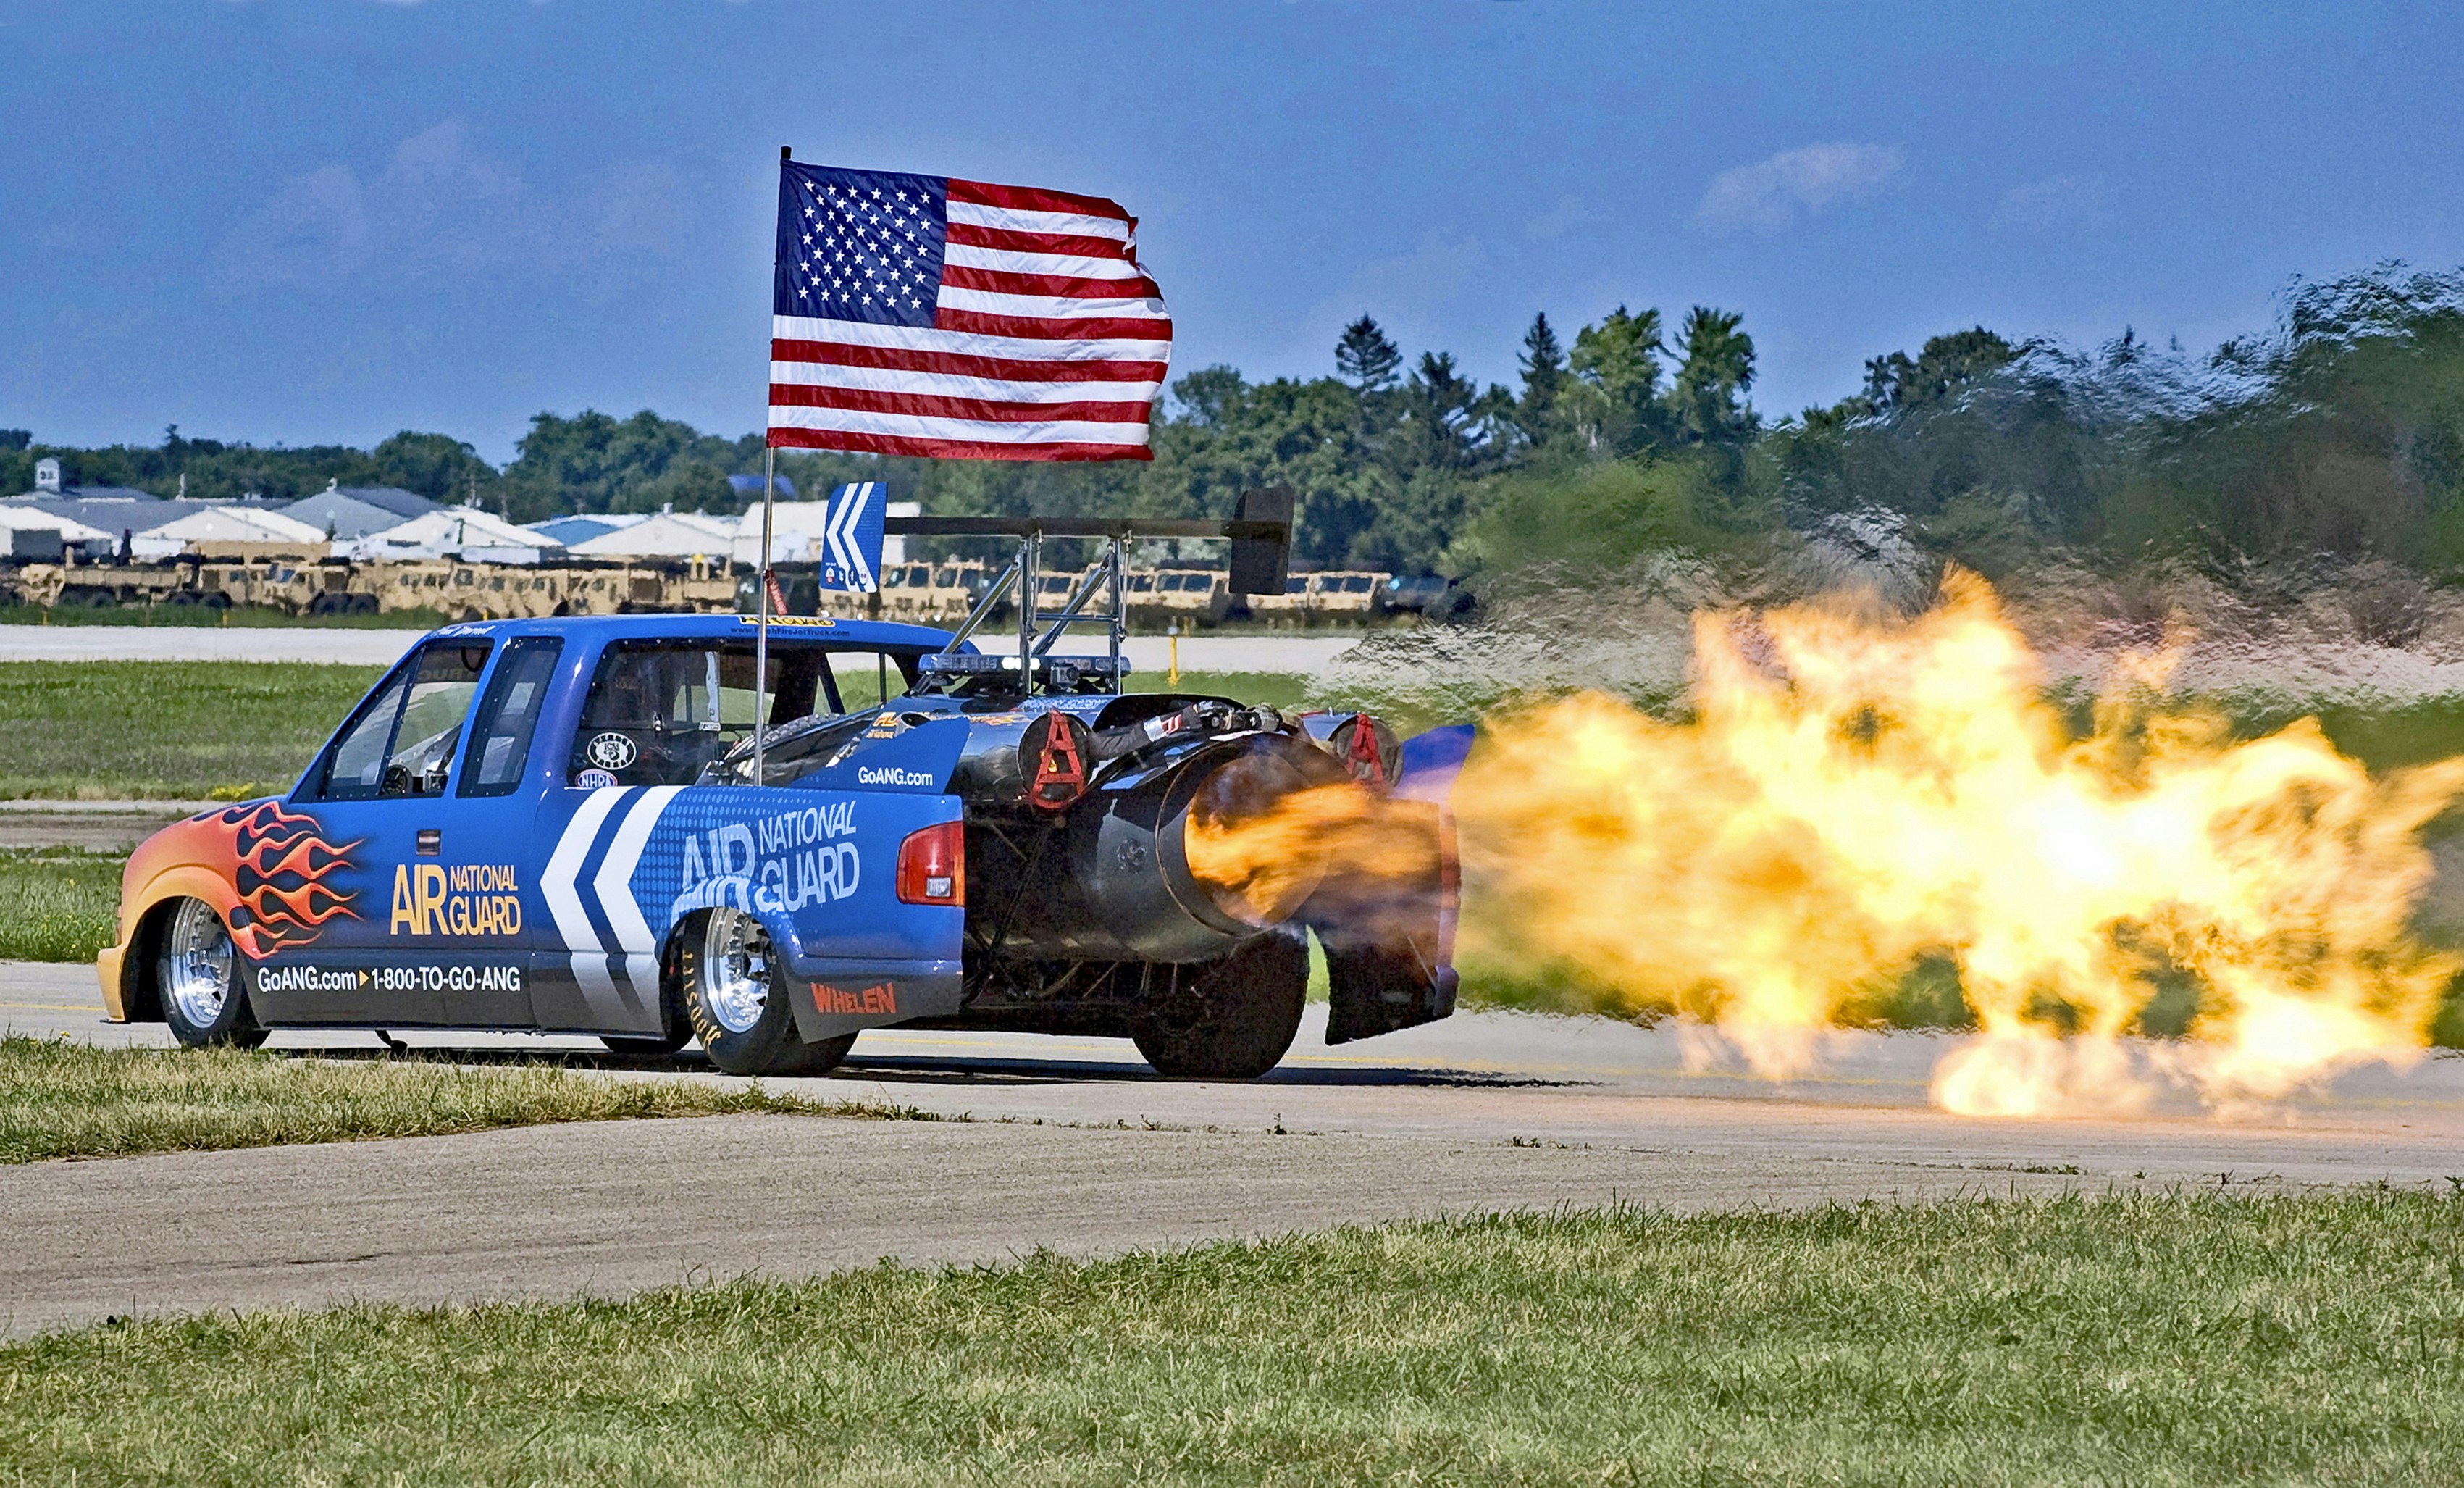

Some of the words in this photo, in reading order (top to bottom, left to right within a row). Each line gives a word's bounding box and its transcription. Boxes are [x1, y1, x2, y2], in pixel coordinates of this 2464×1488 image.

[730, 627, 851, 637] www.FshFireJetTruck.com
[581, 773, 614, 787] NHRA
[858, 766, 934, 787] GoANG.com
[671, 823, 755, 929] AIR
[759, 800, 857, 855] NATIONAL
[755, 842, 860, 913] GUARD
[390, 864, 451, 935] AIR
[449, 864, 519, 892] NATIONAL
[448, 895, 521, 936] GUARD
[257, 966, 358, 992] GoANG.com
[370, 966, 521, 991] 1-800-TO-GO-ANG
[810, 981, 897, 1014] WHELEN
